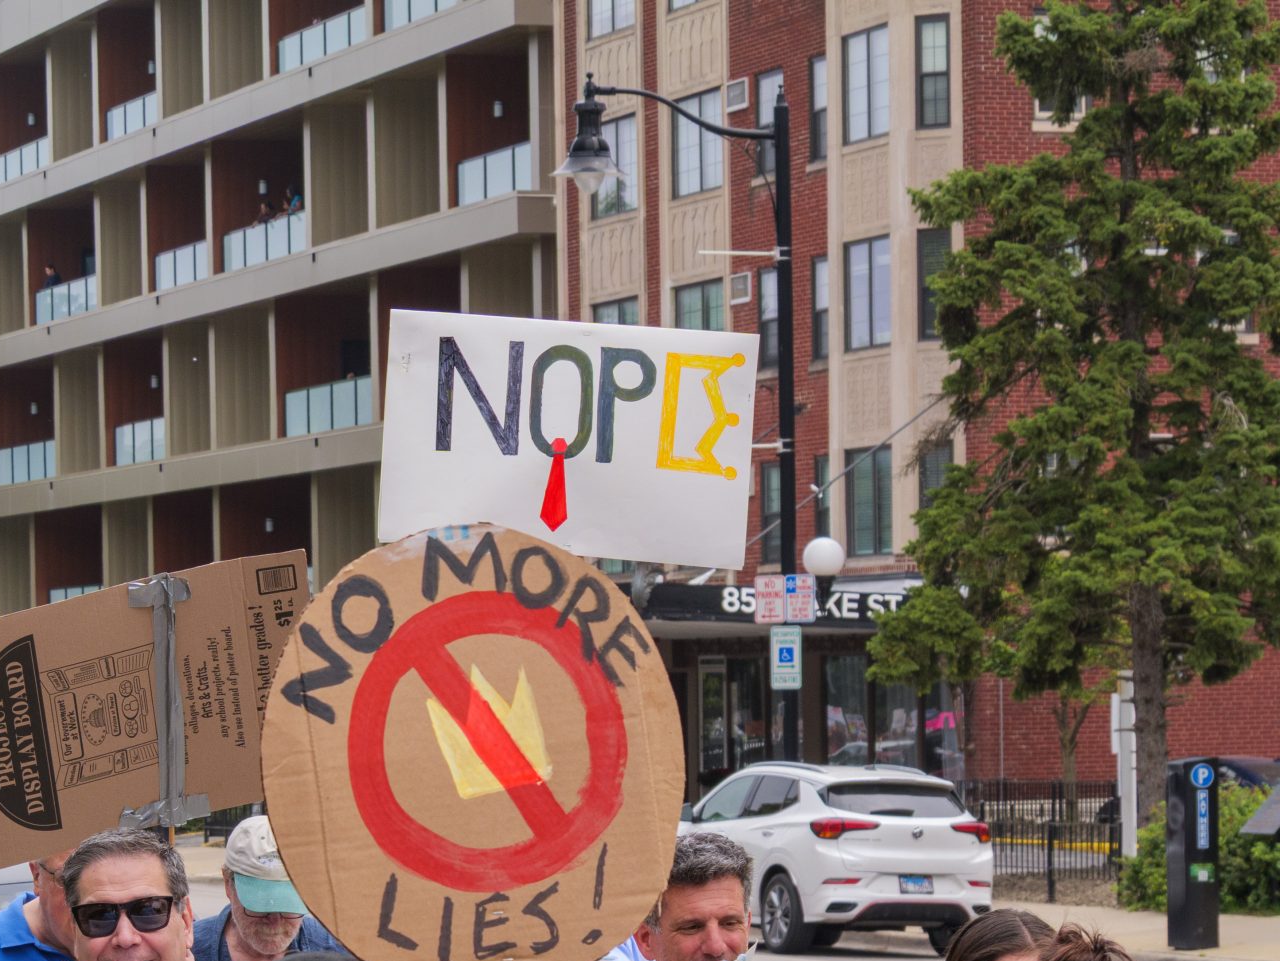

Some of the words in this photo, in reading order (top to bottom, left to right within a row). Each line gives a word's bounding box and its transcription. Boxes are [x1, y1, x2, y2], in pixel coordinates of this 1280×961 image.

[756, 591, 783, 600] PARKING
[764, 581, 776, 590] NO
[722, 586, 756, 614] 85
[866, 593, 904, 616] ST
[220, 625, 235, 652] board.
[279, 574, 395, 725] NO
[421, 531, 651, 688] MORE
[208, 637, 221, 663] really!
[226, 653, 240, 679] poster
[256, 654, 271, 689] better
[5, 661, 33, 730] BOARD
[231, 691, 243, 718] instead
[57, 699, 70, 743] Government
[67, 710, 78, 733] Work
[200, 700, 213, 719] Arts
[216, 700, 227, 725] school
[220, 725, 230, 739] any
[234, 729, 247, 749] Also
[15, 731, 45, 816] DISPLAY
